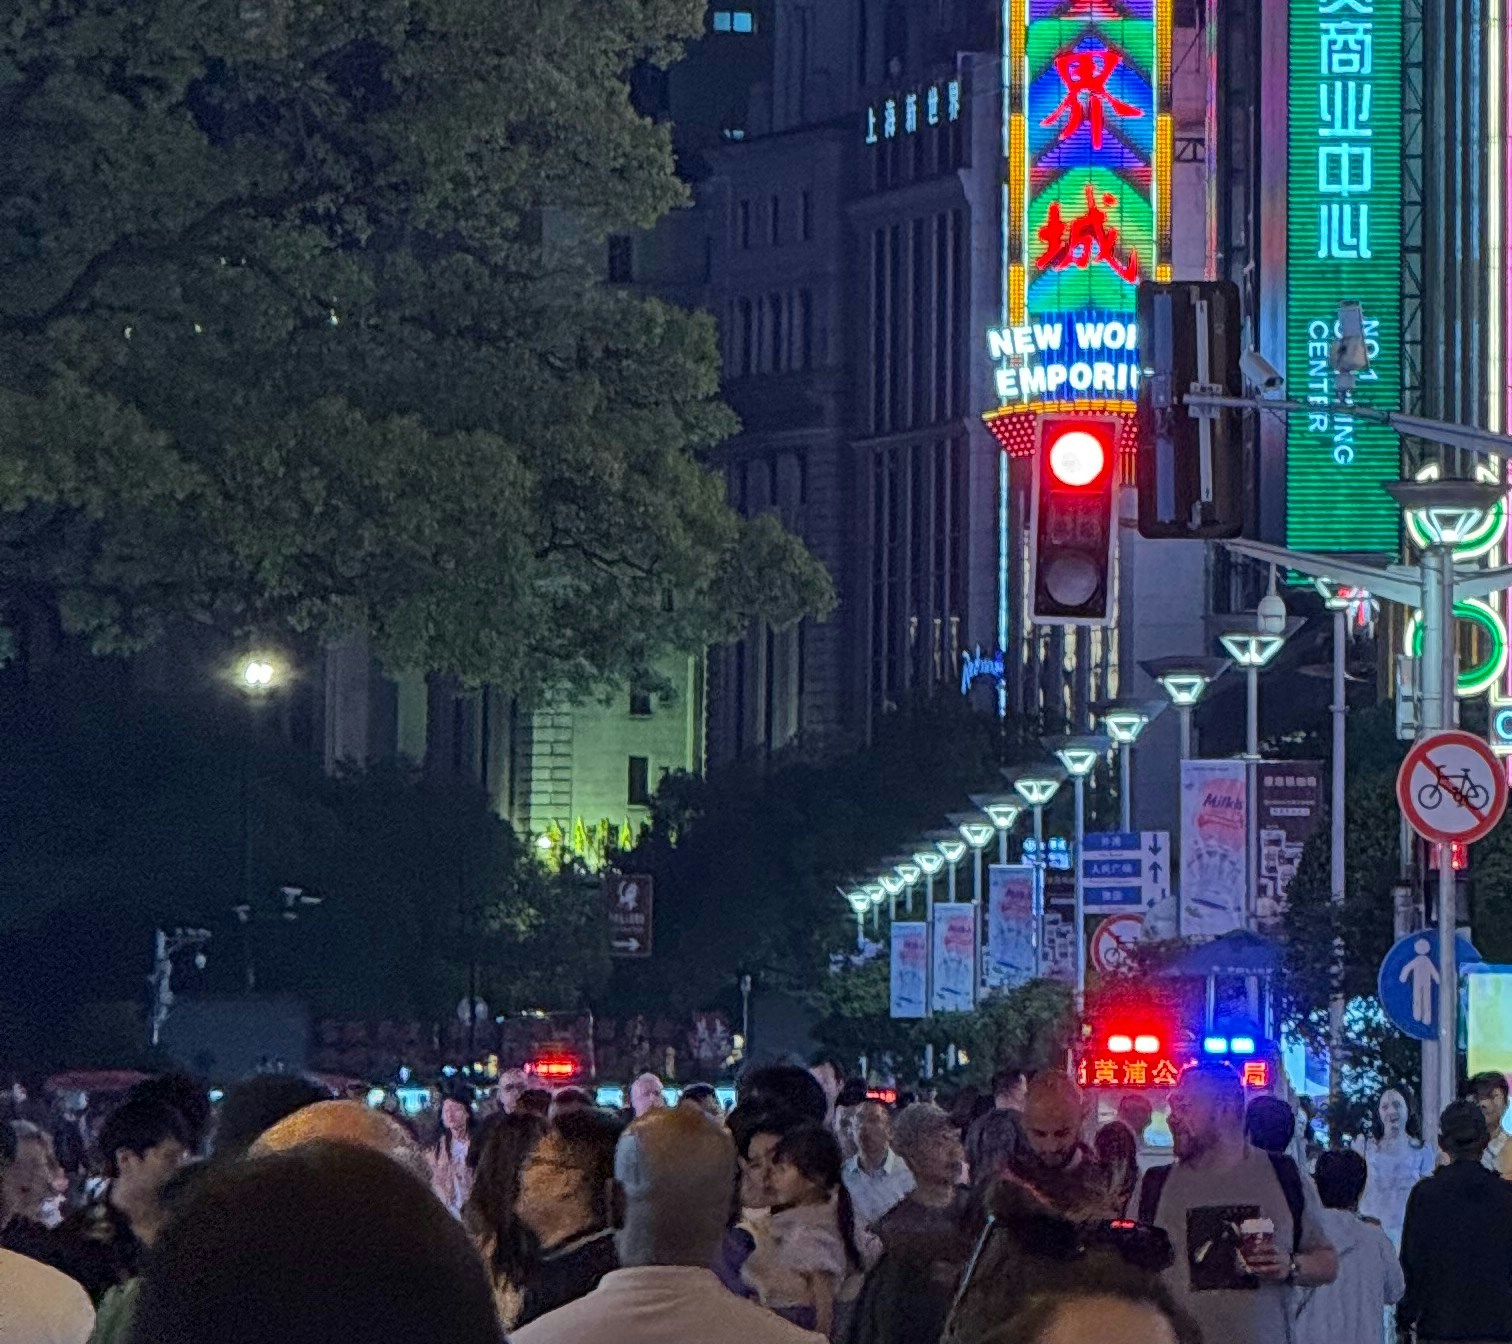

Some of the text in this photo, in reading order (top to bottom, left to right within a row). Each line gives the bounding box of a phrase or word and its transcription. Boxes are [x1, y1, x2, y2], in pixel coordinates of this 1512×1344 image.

[986, 321, 1063, 361] NEW
[1077, 1057, 1269, 1087] 黄浦公局
